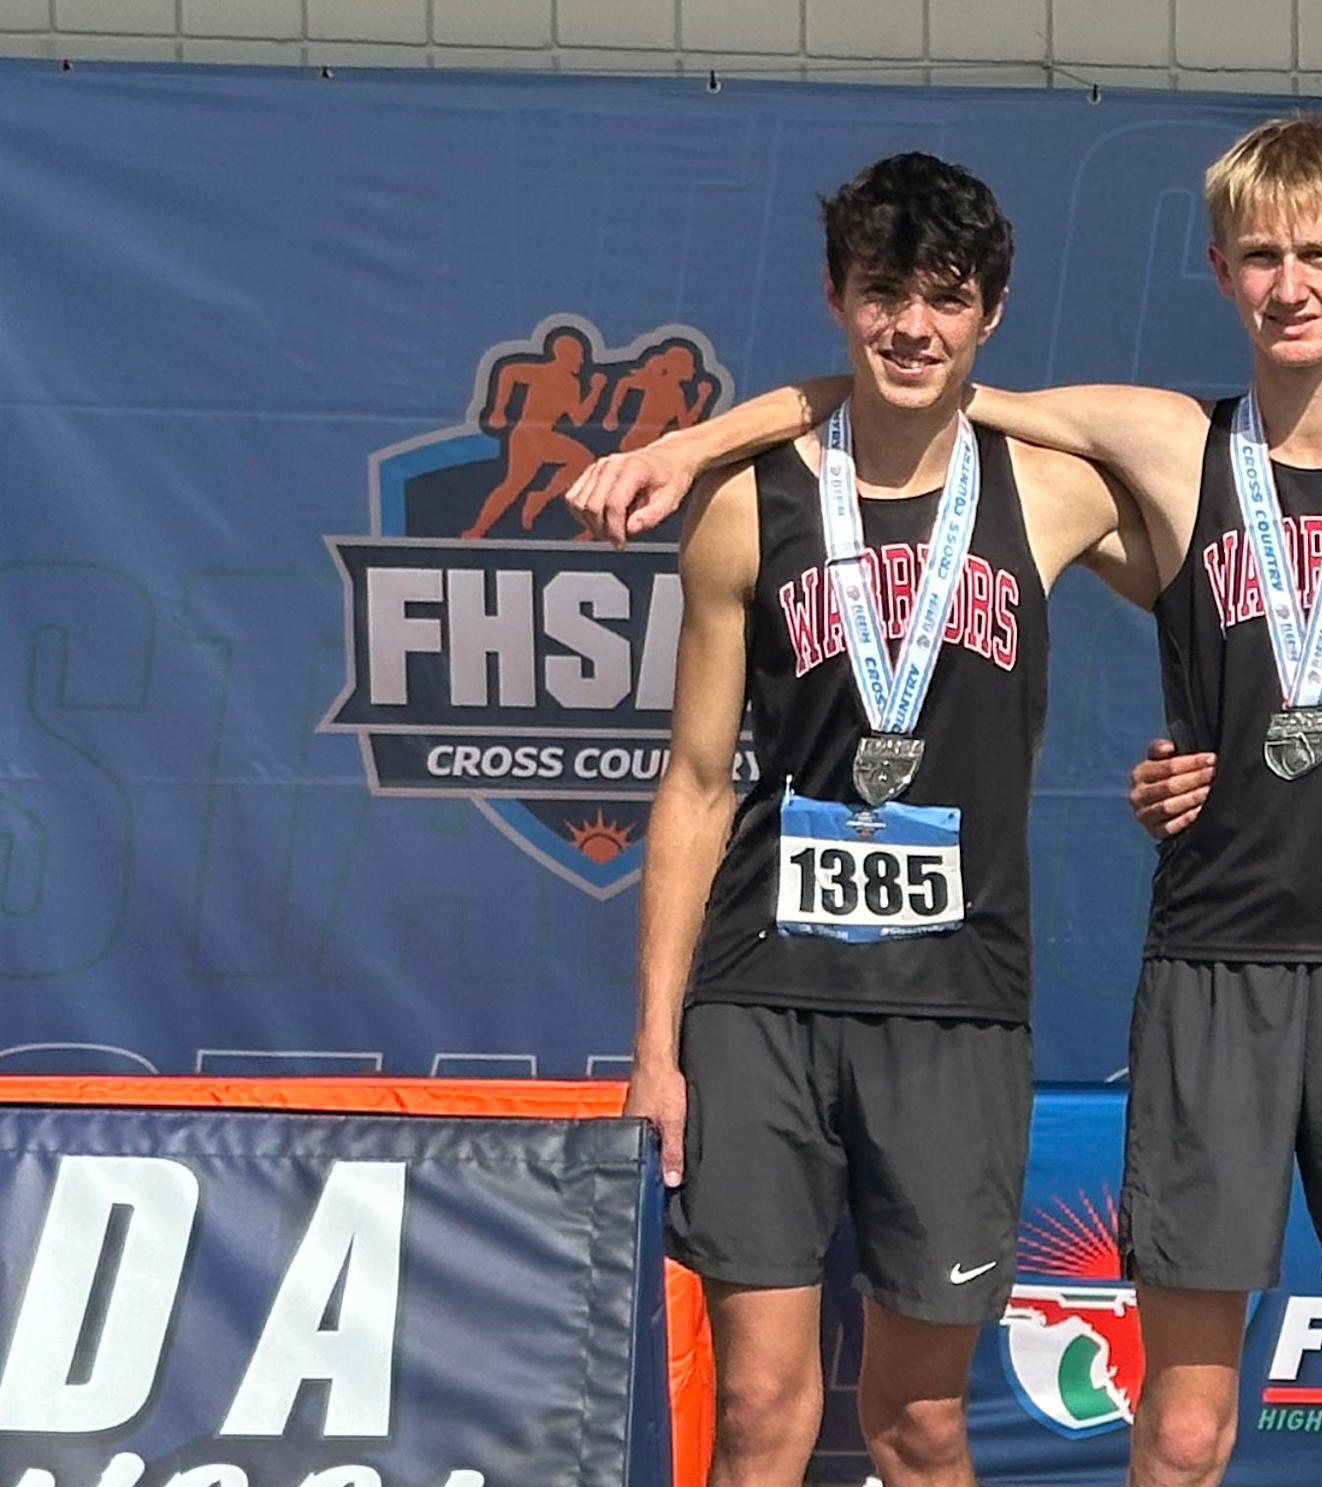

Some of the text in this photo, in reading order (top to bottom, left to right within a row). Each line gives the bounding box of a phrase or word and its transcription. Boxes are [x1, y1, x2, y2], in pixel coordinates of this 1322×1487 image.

[937, 444, 973, 581] CROSS COUNTRY
[1241, 445, 1264, 504] CROSS
[1255, 509, 1284, 593] COUNTRY
[366, 567, 684, 711] FHS
[865, 656, 890, 709] CROS
[890, 664, 921, 733] OUNTRY
[427, 745, 760, 783] CROSS COURY
[790, 847, 948, 917] 1385
